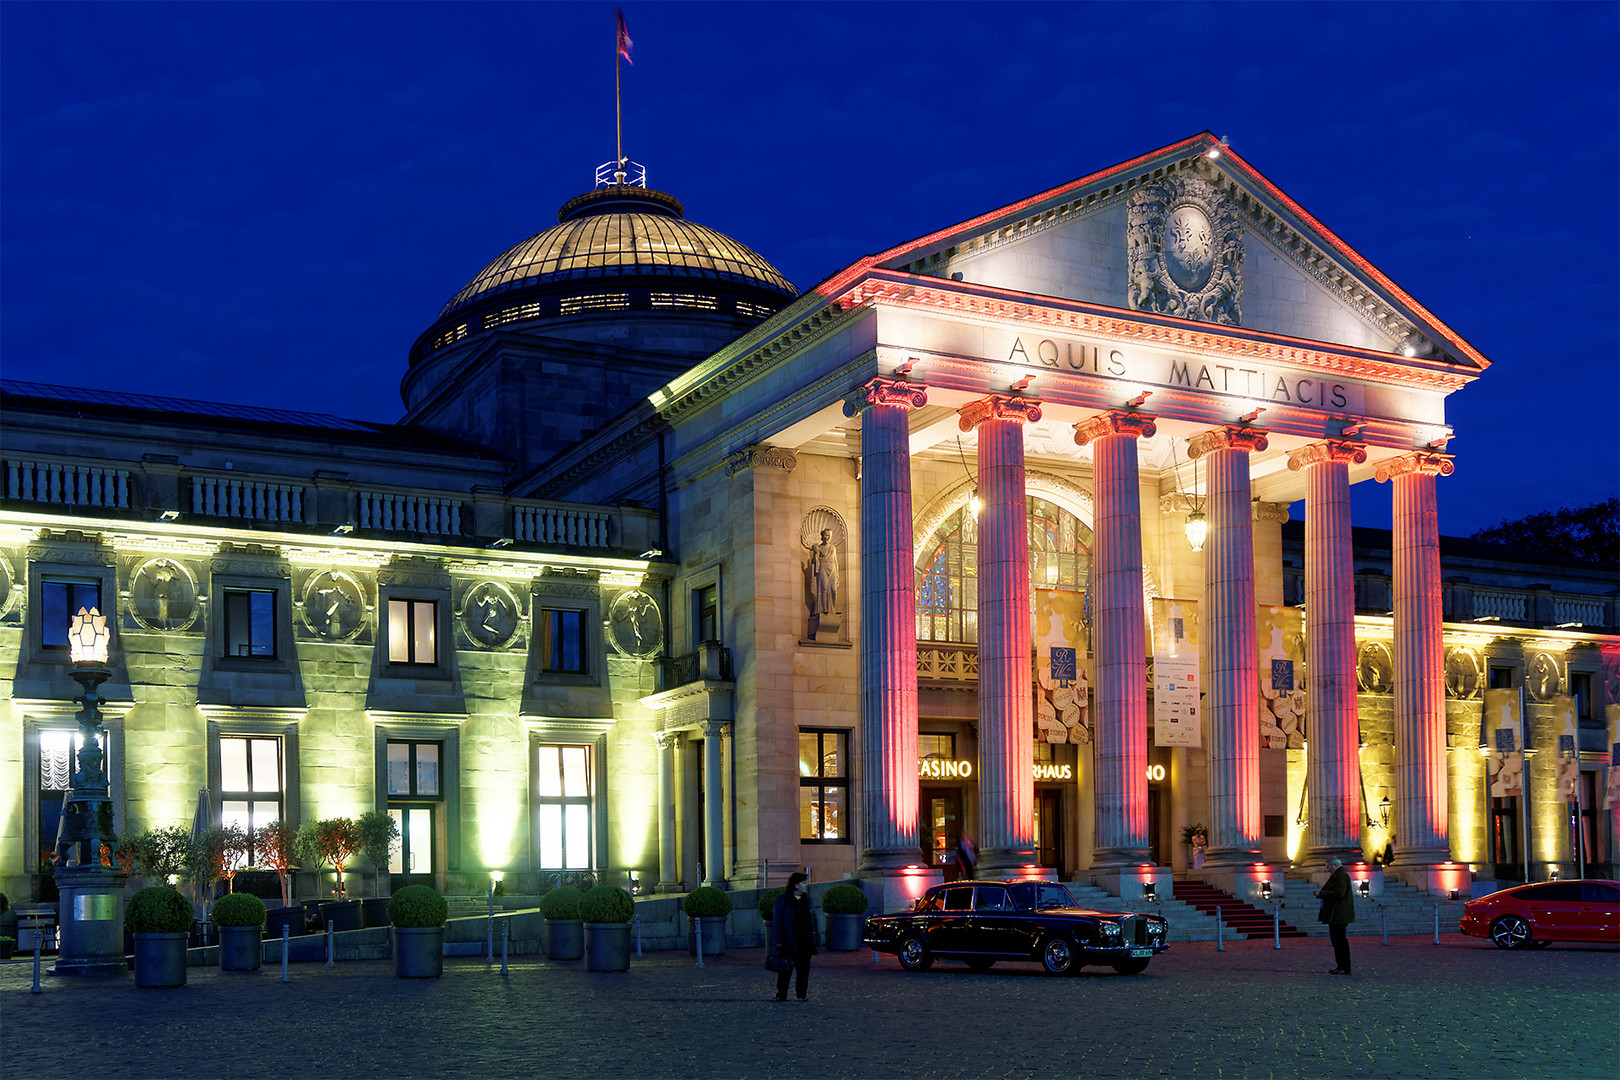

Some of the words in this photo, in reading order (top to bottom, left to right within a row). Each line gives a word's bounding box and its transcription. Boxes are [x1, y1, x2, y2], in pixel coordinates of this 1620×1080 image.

[1009, 336, 1127, 376] AQUIS
[1168, 359, 1348, 408] MATTIACIS
[917, 760, 972, 777] ASINO
